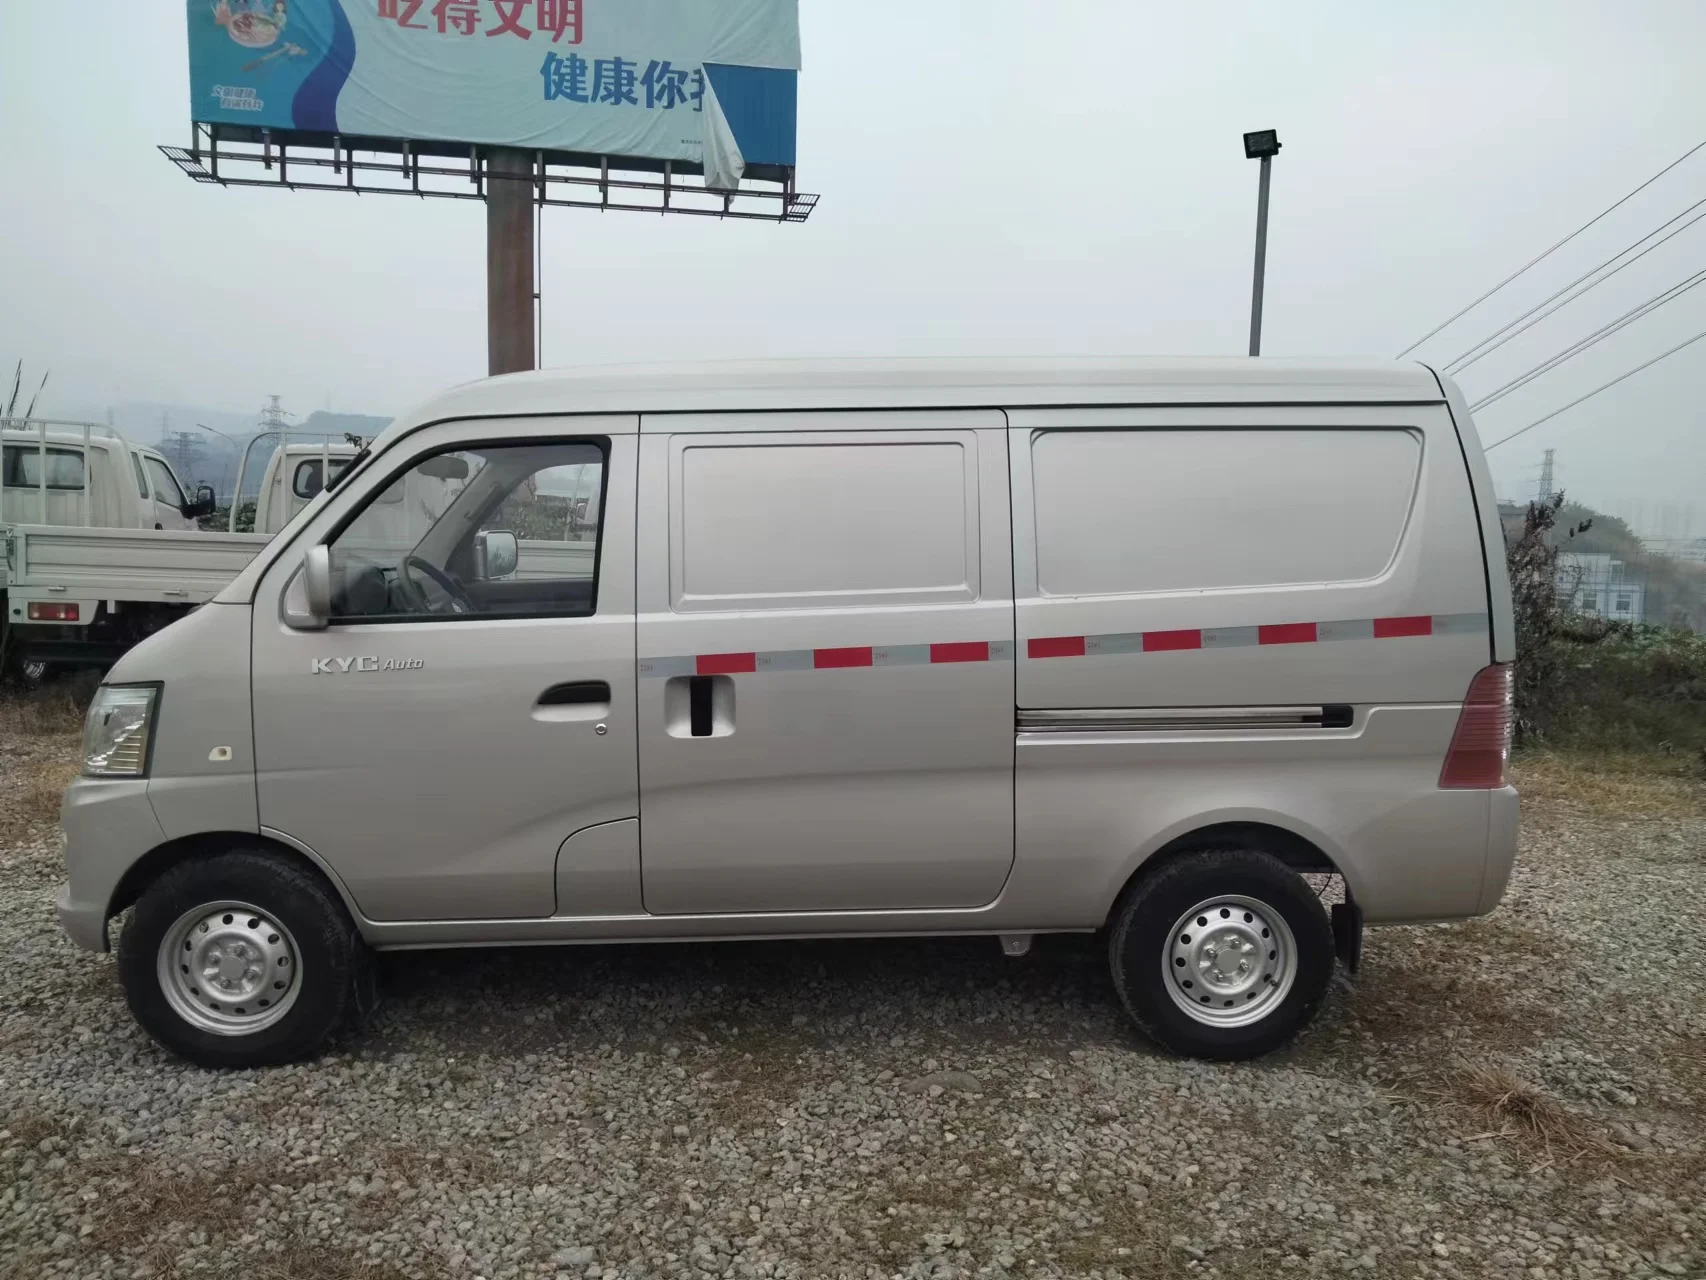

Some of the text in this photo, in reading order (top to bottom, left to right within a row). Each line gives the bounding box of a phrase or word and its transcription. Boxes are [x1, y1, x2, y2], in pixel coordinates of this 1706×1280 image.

[377, 0, 583, 45] 吃得文明
[311, 656, 424, 674] KYC Auto
